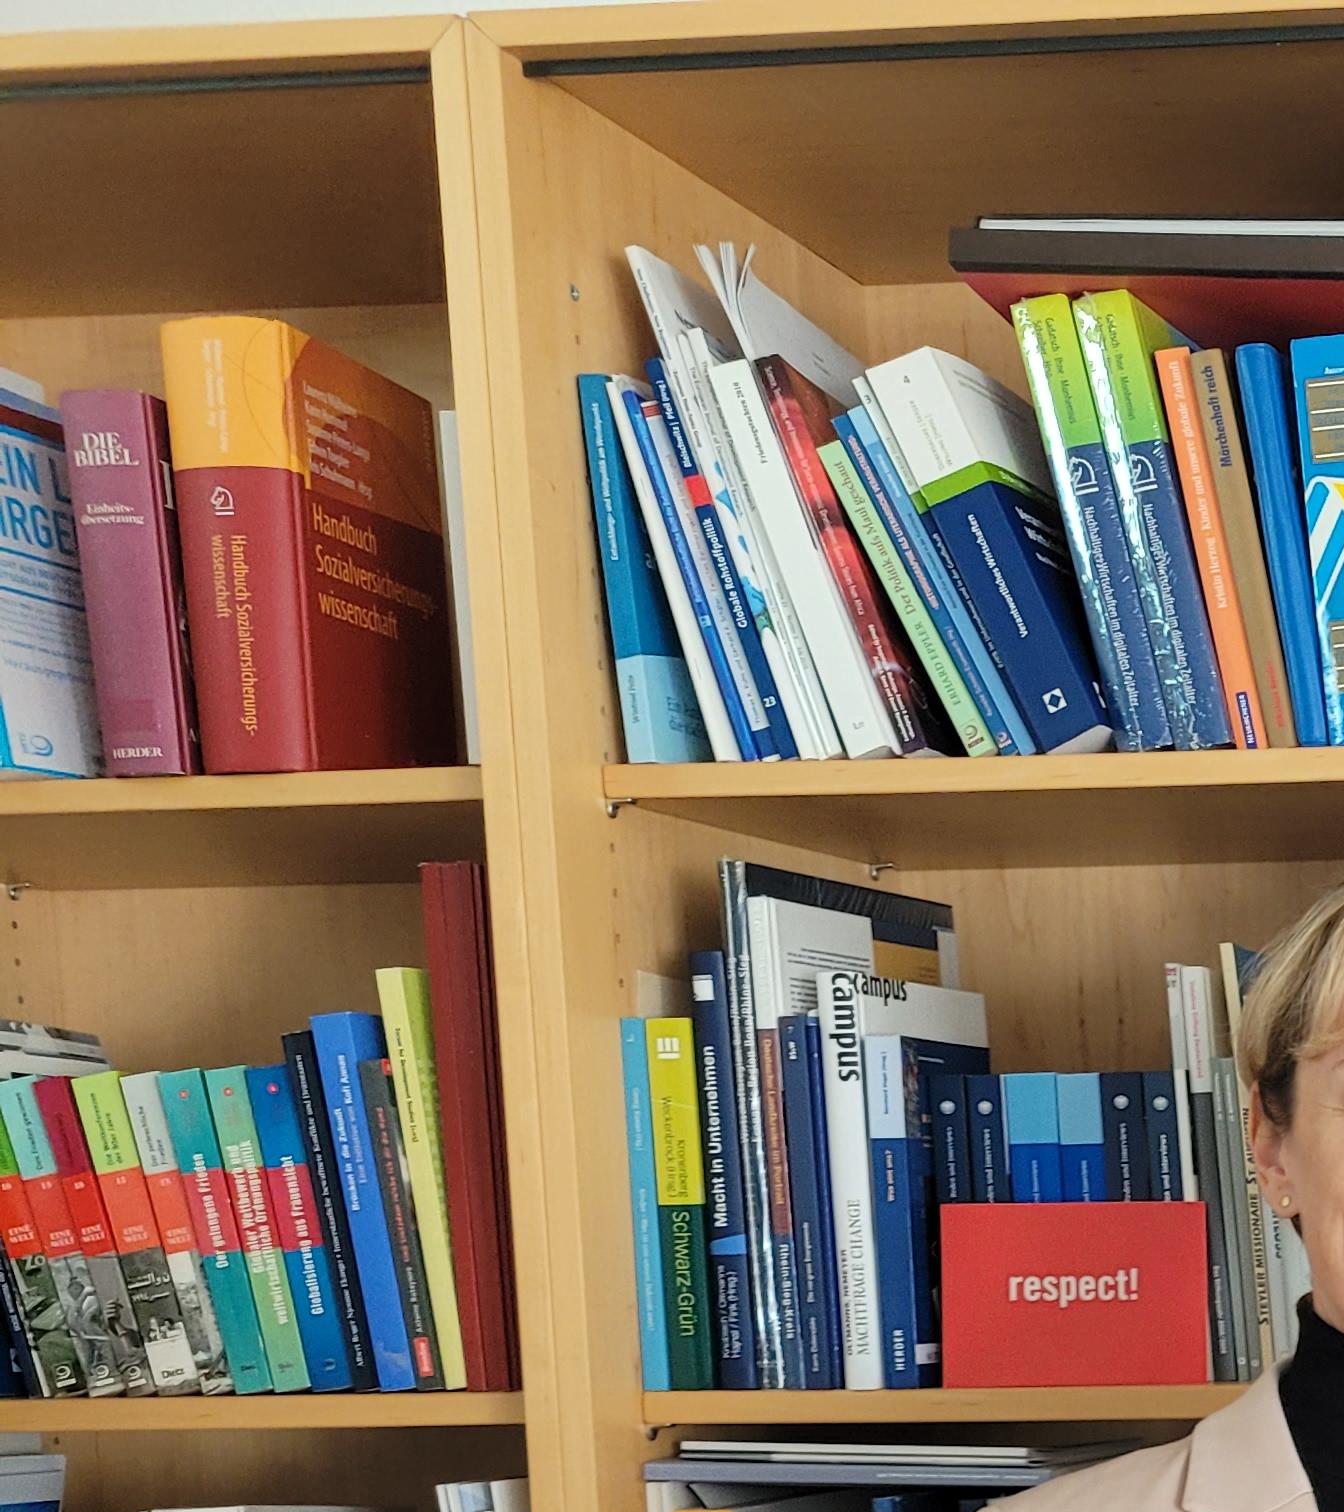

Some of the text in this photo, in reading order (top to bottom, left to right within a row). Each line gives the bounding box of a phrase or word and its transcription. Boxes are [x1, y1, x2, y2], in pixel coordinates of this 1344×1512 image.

[74, 448, 140, 467] BIBEL
[81, 432, 122, 450] DIE
[1200, 365, 1232, 467] Märchenhaft reich
[211, 534, 232, 619] wissenschaft
[313, 503, 377, 555] Handbuch
[702, 518, 748, 628] Globale Rohstoffpolitik
[967, 514, 1029, 638] Verantwortliches Wirtschaften
[231, 535, 258, 737] Handbuch Sozialversicherungs-
[319, 591, 399, 640] wissenschaft
[112, 747, 163, 759] HERDER
[831, 971, 860, 1082] campus
[703, 1045, 730, 1228] Macht in Unternehmen
[280, 1155, 325, 1316] Globalisierung aus Frauensicht
[671, 1210, 695, 1338] Schwarz-Grün
[1008, 1267, 1139, 1308] respect!
[1249, 1192, 1269, 1326] STEYLER MISSIONARE
